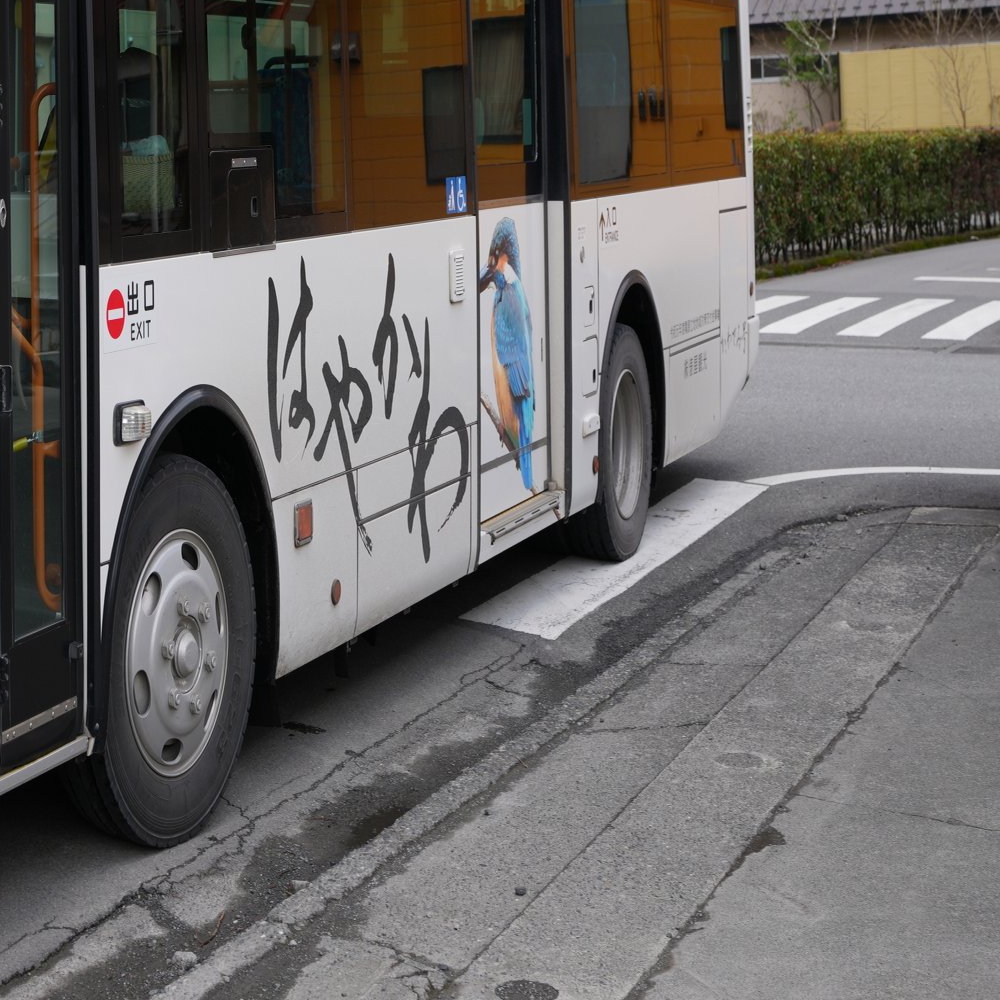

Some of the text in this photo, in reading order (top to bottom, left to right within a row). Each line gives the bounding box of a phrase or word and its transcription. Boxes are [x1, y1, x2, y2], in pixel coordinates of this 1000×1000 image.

[606, 206, 617, 227] 入口
[127, 279, 155, 316] 出口
[130, 319, 151, 341] EXIT
[267, 253, 469, 563] はやかわ
